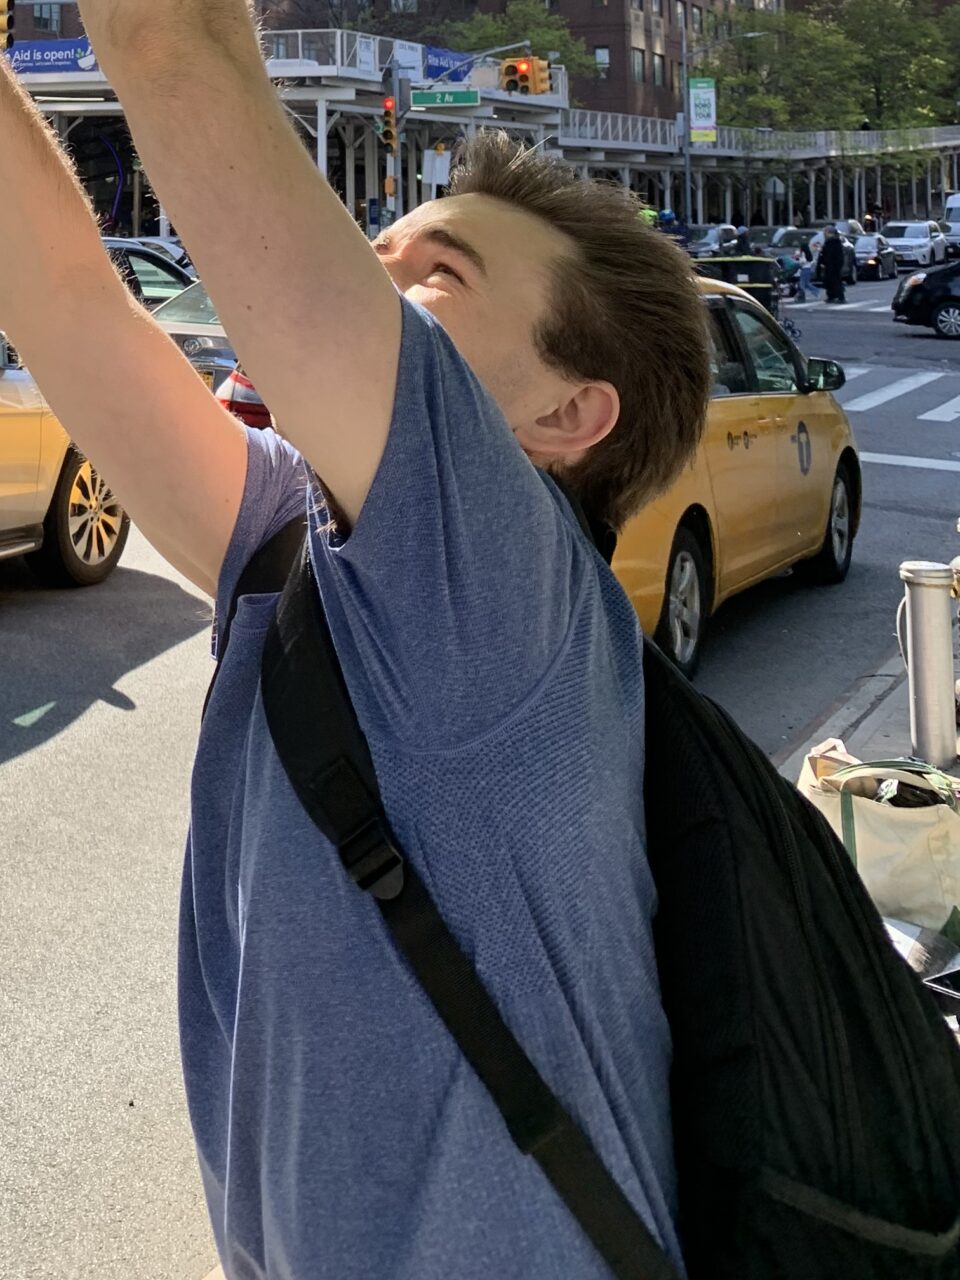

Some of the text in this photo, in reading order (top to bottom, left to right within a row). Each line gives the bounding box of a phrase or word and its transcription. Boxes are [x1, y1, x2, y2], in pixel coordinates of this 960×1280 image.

[13, 48, 75, 62] Aid is open!
[435, 93, 454, 103] 2 Av
